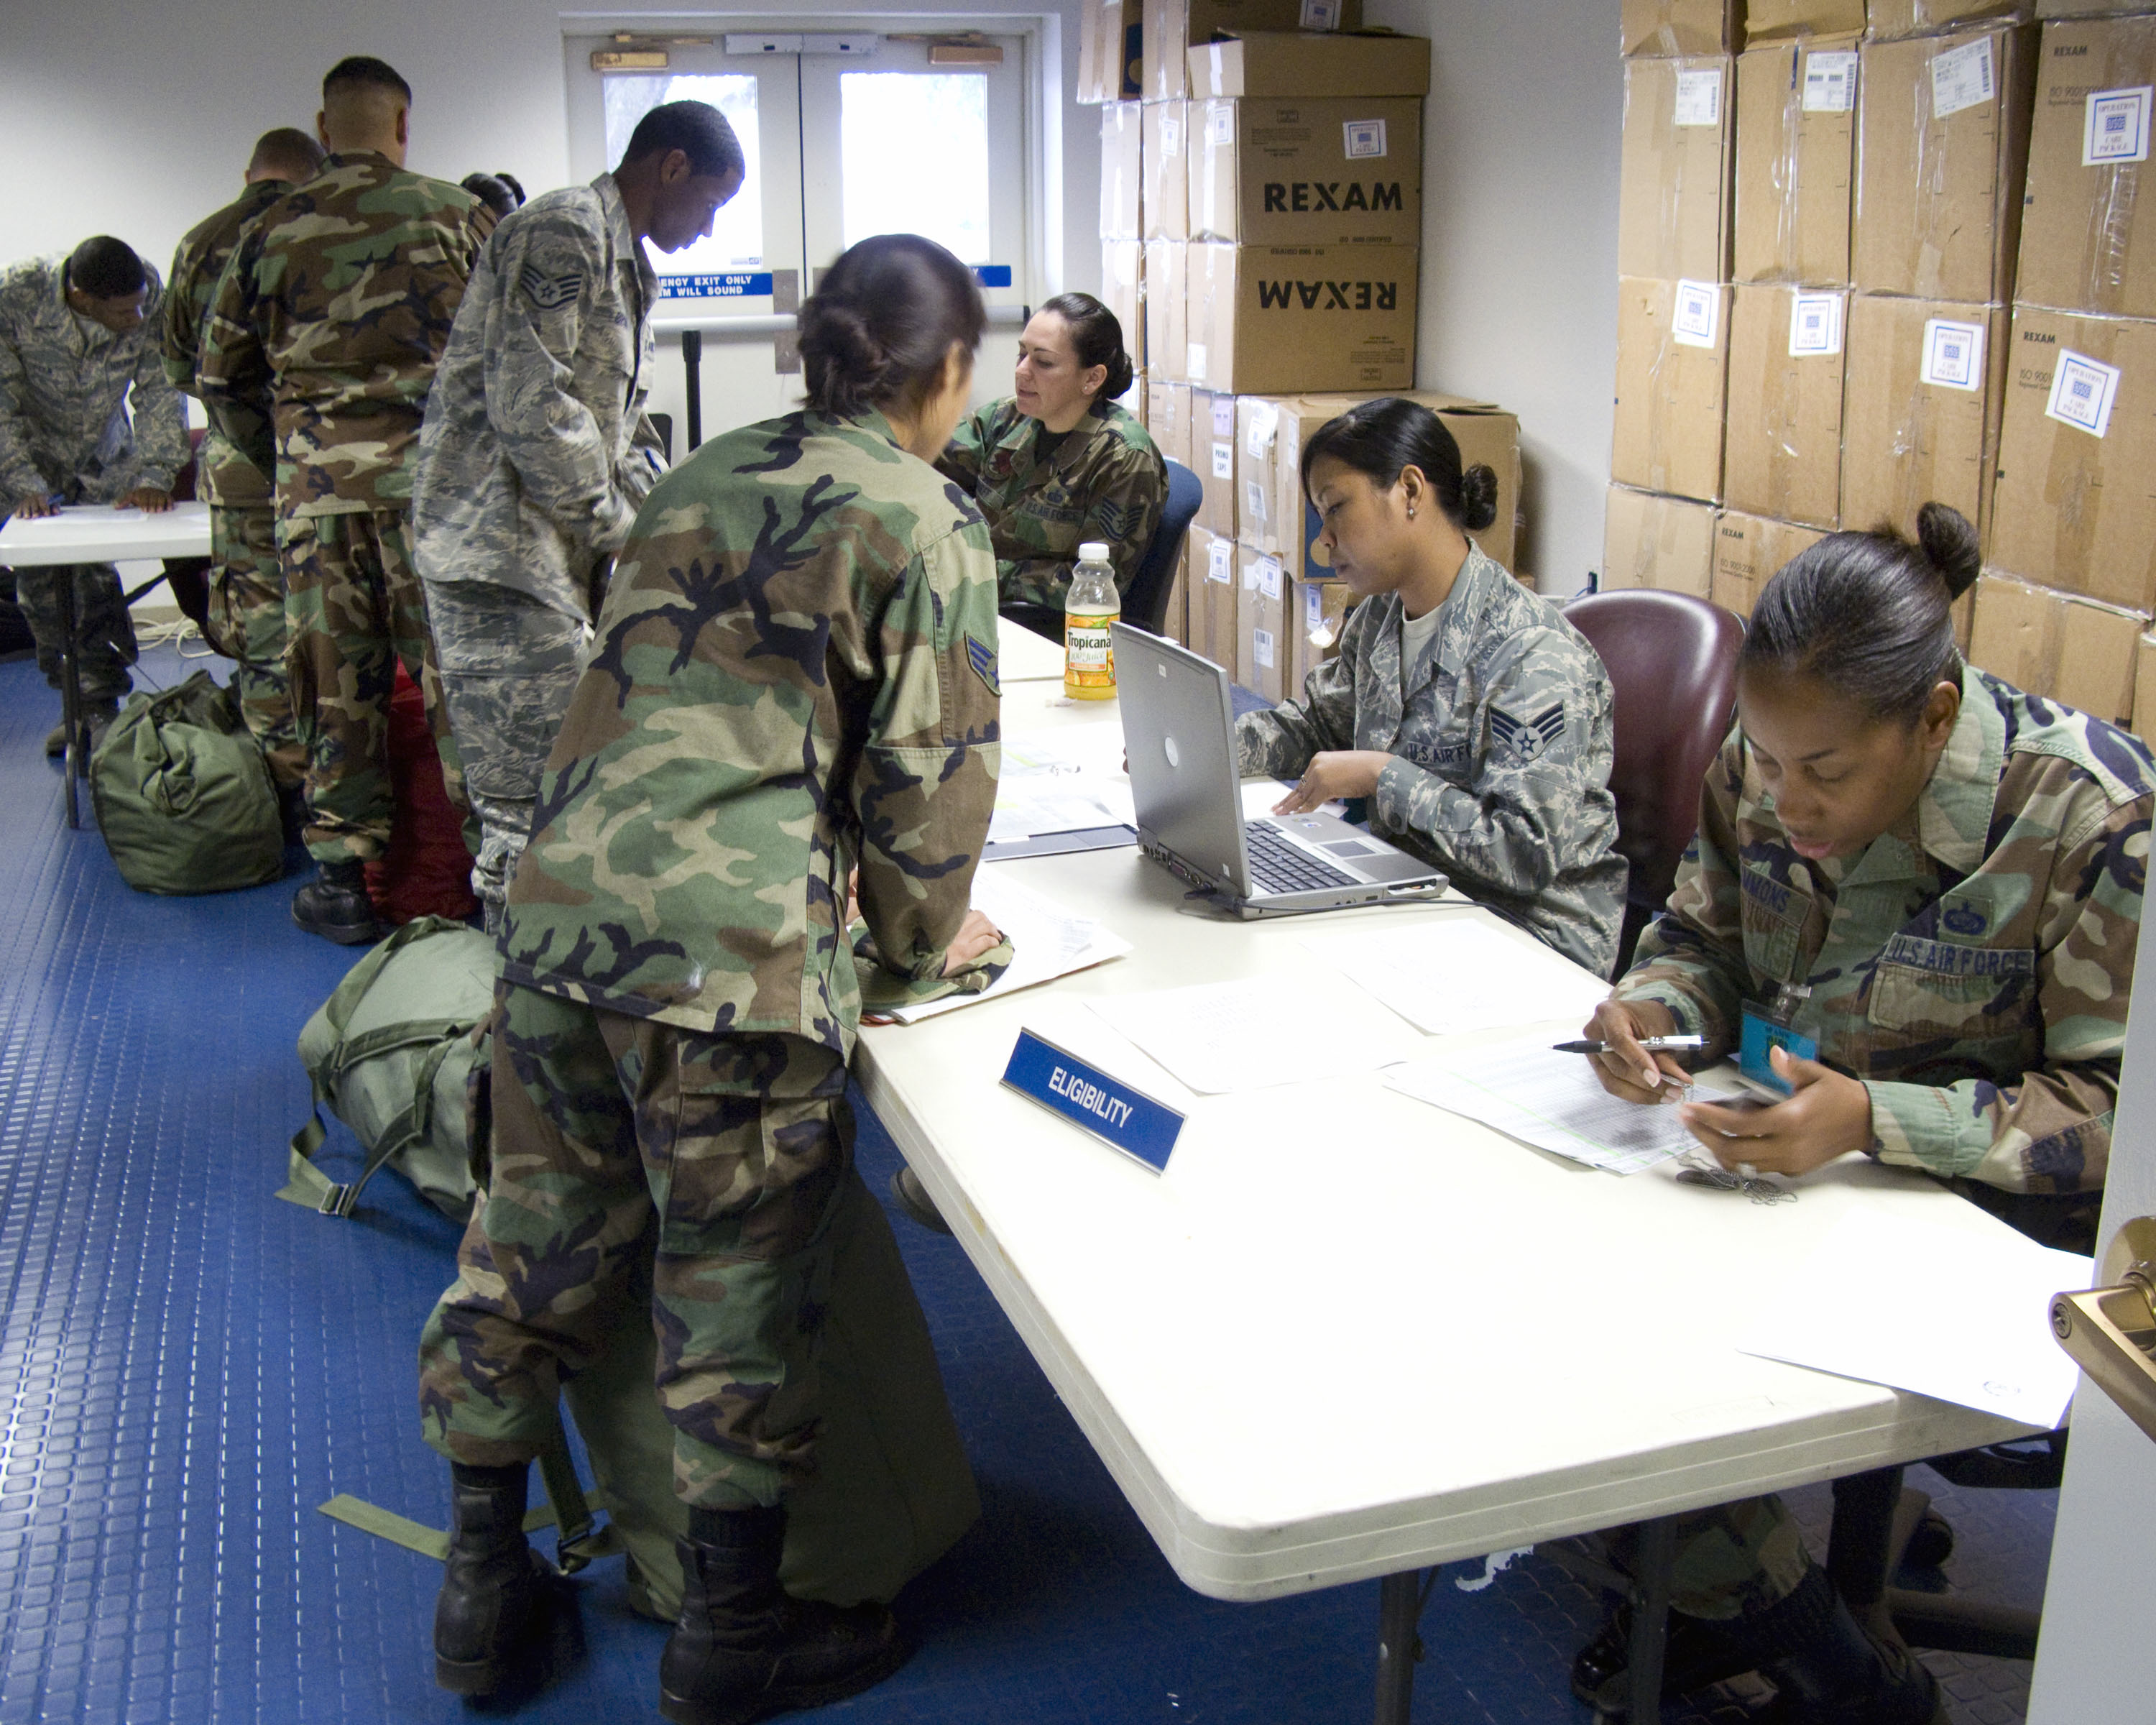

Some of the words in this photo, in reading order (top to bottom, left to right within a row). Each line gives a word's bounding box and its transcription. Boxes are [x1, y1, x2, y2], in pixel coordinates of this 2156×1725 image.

[2054, 45, 2088, 57] REXAM
[1264, 183, 1403, 212] REXAM
[660, 277, 688, 288] ENCY
[694, 277, 721, 287] EXIT
[726, 275, 752, 285] ONLY
[677, 288, 701, 296] WILL
[707, 286, 743, 295] SOUND
[1258, 280, 1397, 310] REXAM
[2023, 331, 2055, 344] REXAM
[2019, 369, 2032, 380] ISO
[1215, 449, 1229, 459] PROMO
[1722, 527, 1743, 539] REXAM
[1067, 632, 1111, 650] Tropicana
[1433, 748, 1455, 762] AIR
[1926, 944, 1955, 974] AIR
[1960, 948, 2027, 976] FORCE
[1049, 1066, 1133, 1128] ELIGIBILITY
